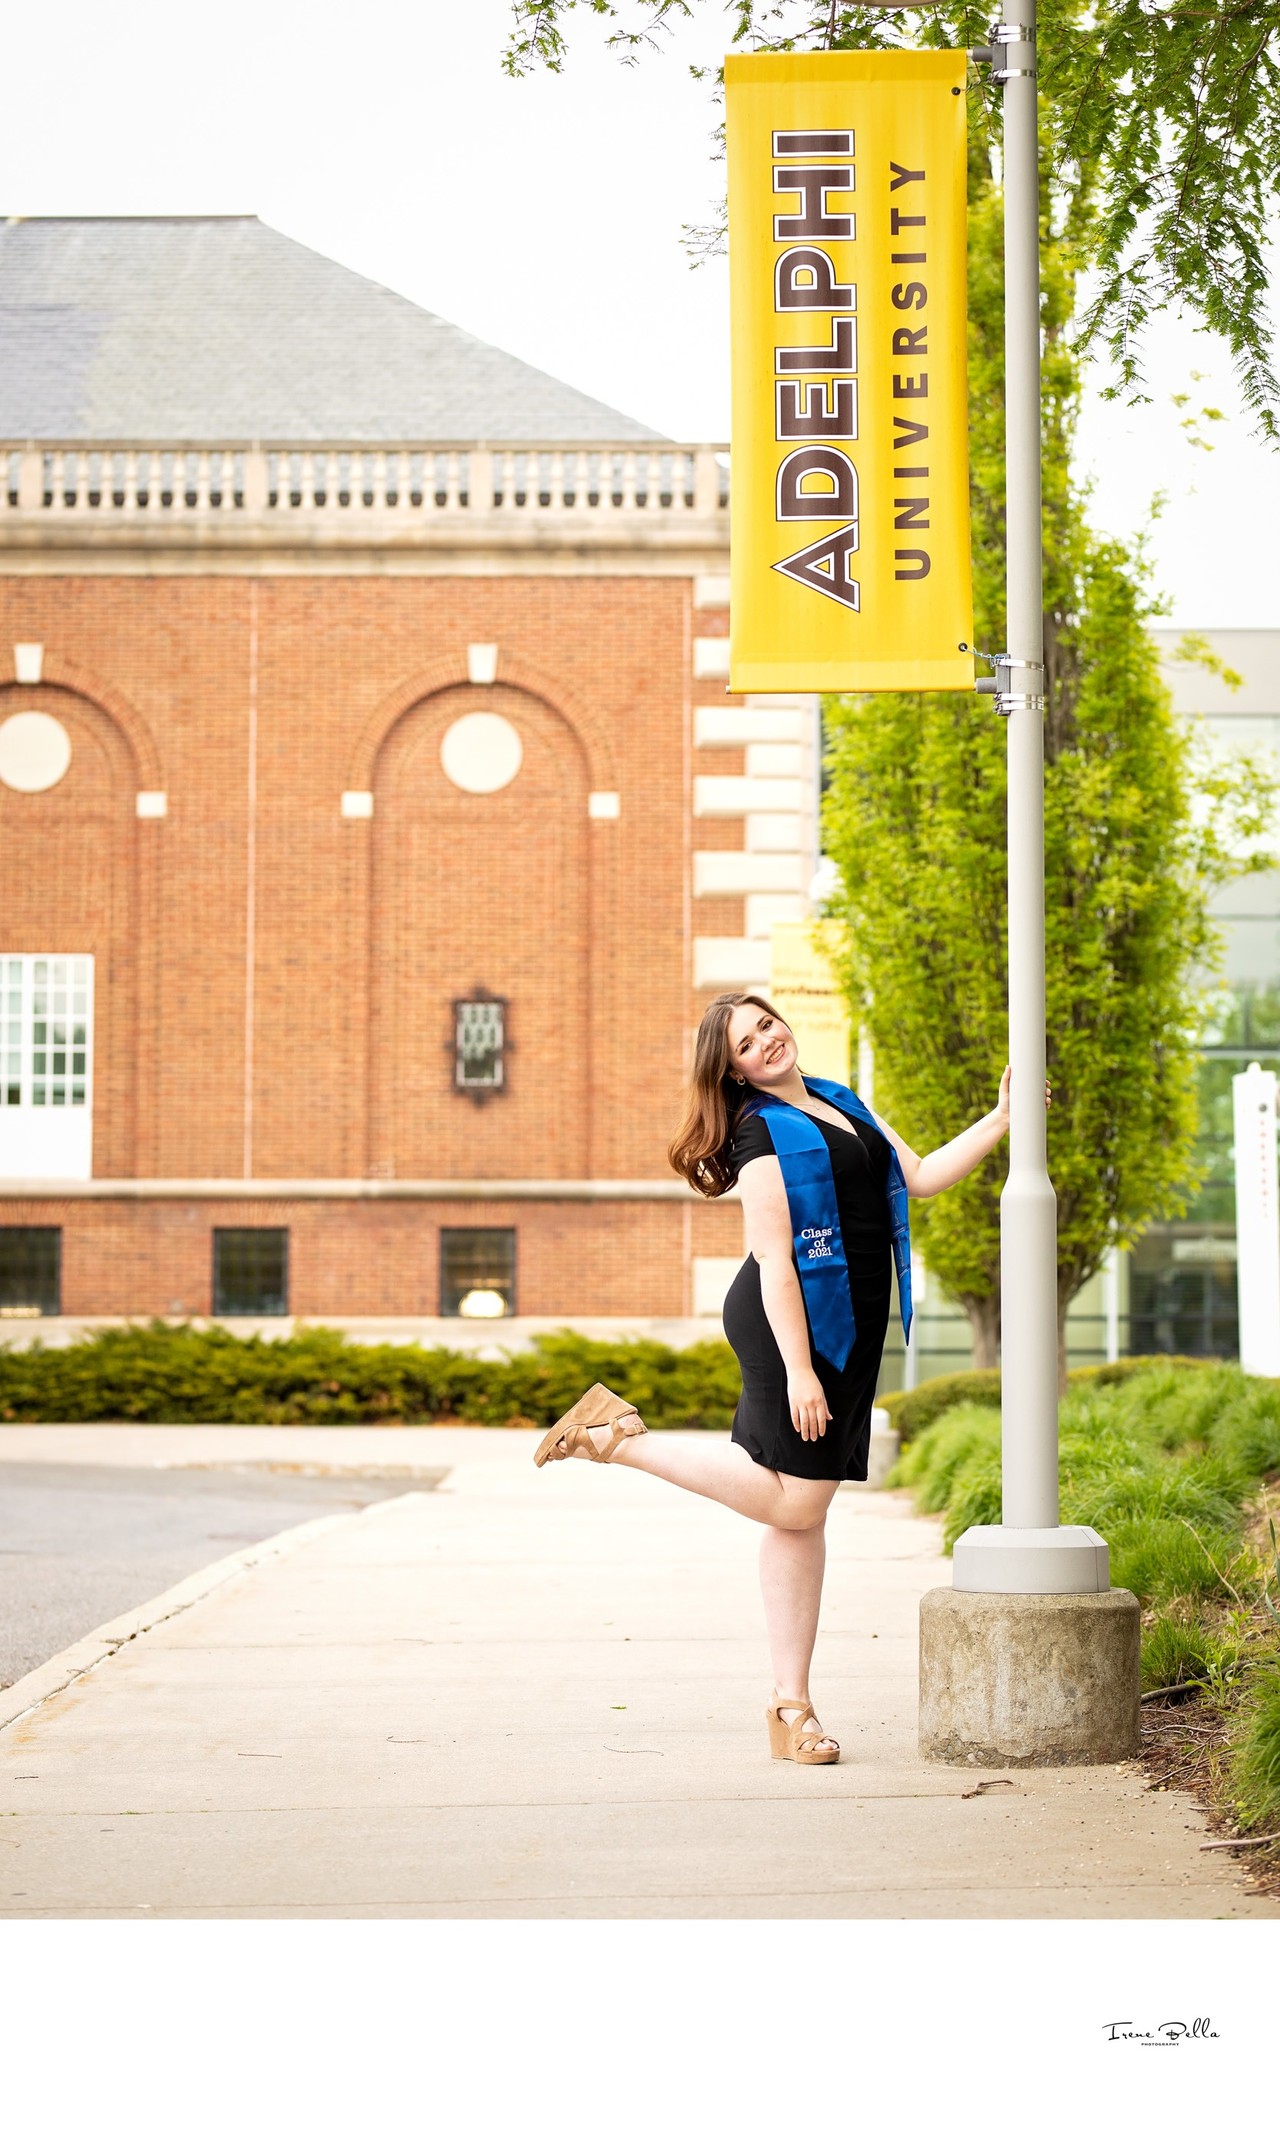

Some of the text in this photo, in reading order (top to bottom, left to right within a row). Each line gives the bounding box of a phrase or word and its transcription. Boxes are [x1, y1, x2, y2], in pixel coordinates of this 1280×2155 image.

[771, 129, 860, 613] ADELPHI
[890, 161, 932, 581] UNIVERSITY
[801, 1228, 832, 1239] Class
[814, 1237, 825, 1247] of
[808, 1247, 833, 1258] 2021
